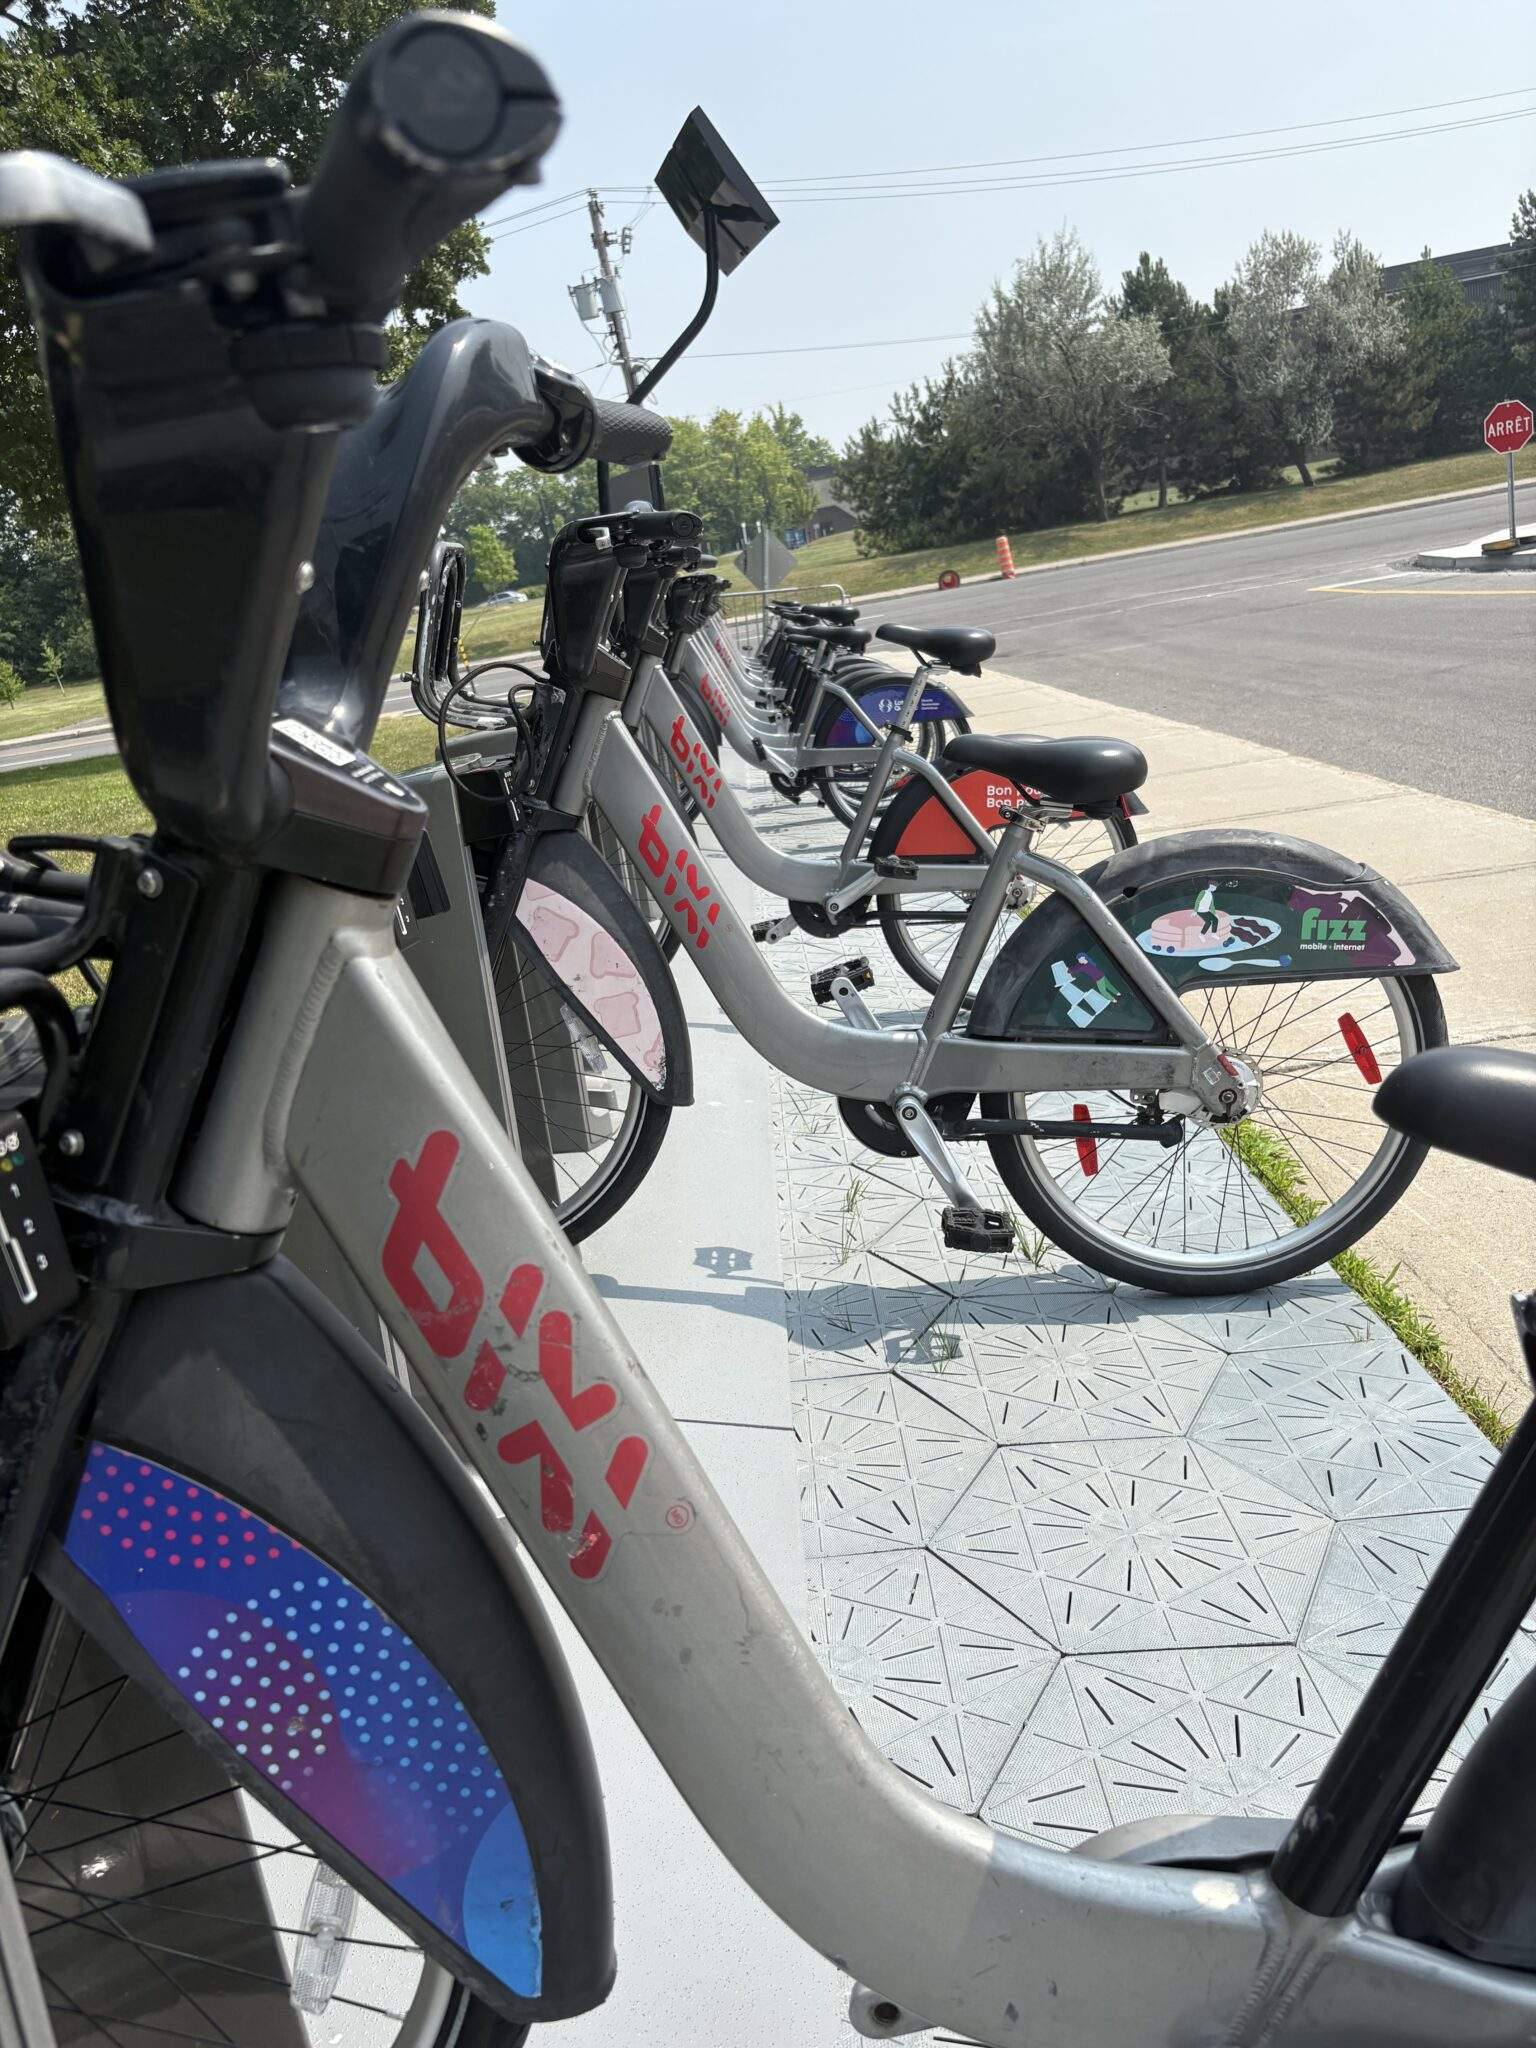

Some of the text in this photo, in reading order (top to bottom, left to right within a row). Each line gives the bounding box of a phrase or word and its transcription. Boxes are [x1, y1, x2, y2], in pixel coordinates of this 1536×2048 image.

[1487, 415, 1530, 438] ARRÊT
[987, 785, 1012, 796] Bon
[1301, 907, 1367, 940] fizz
[1333, 943, 1365, 951] internet
[23, 1218, 36, 1235] 2
